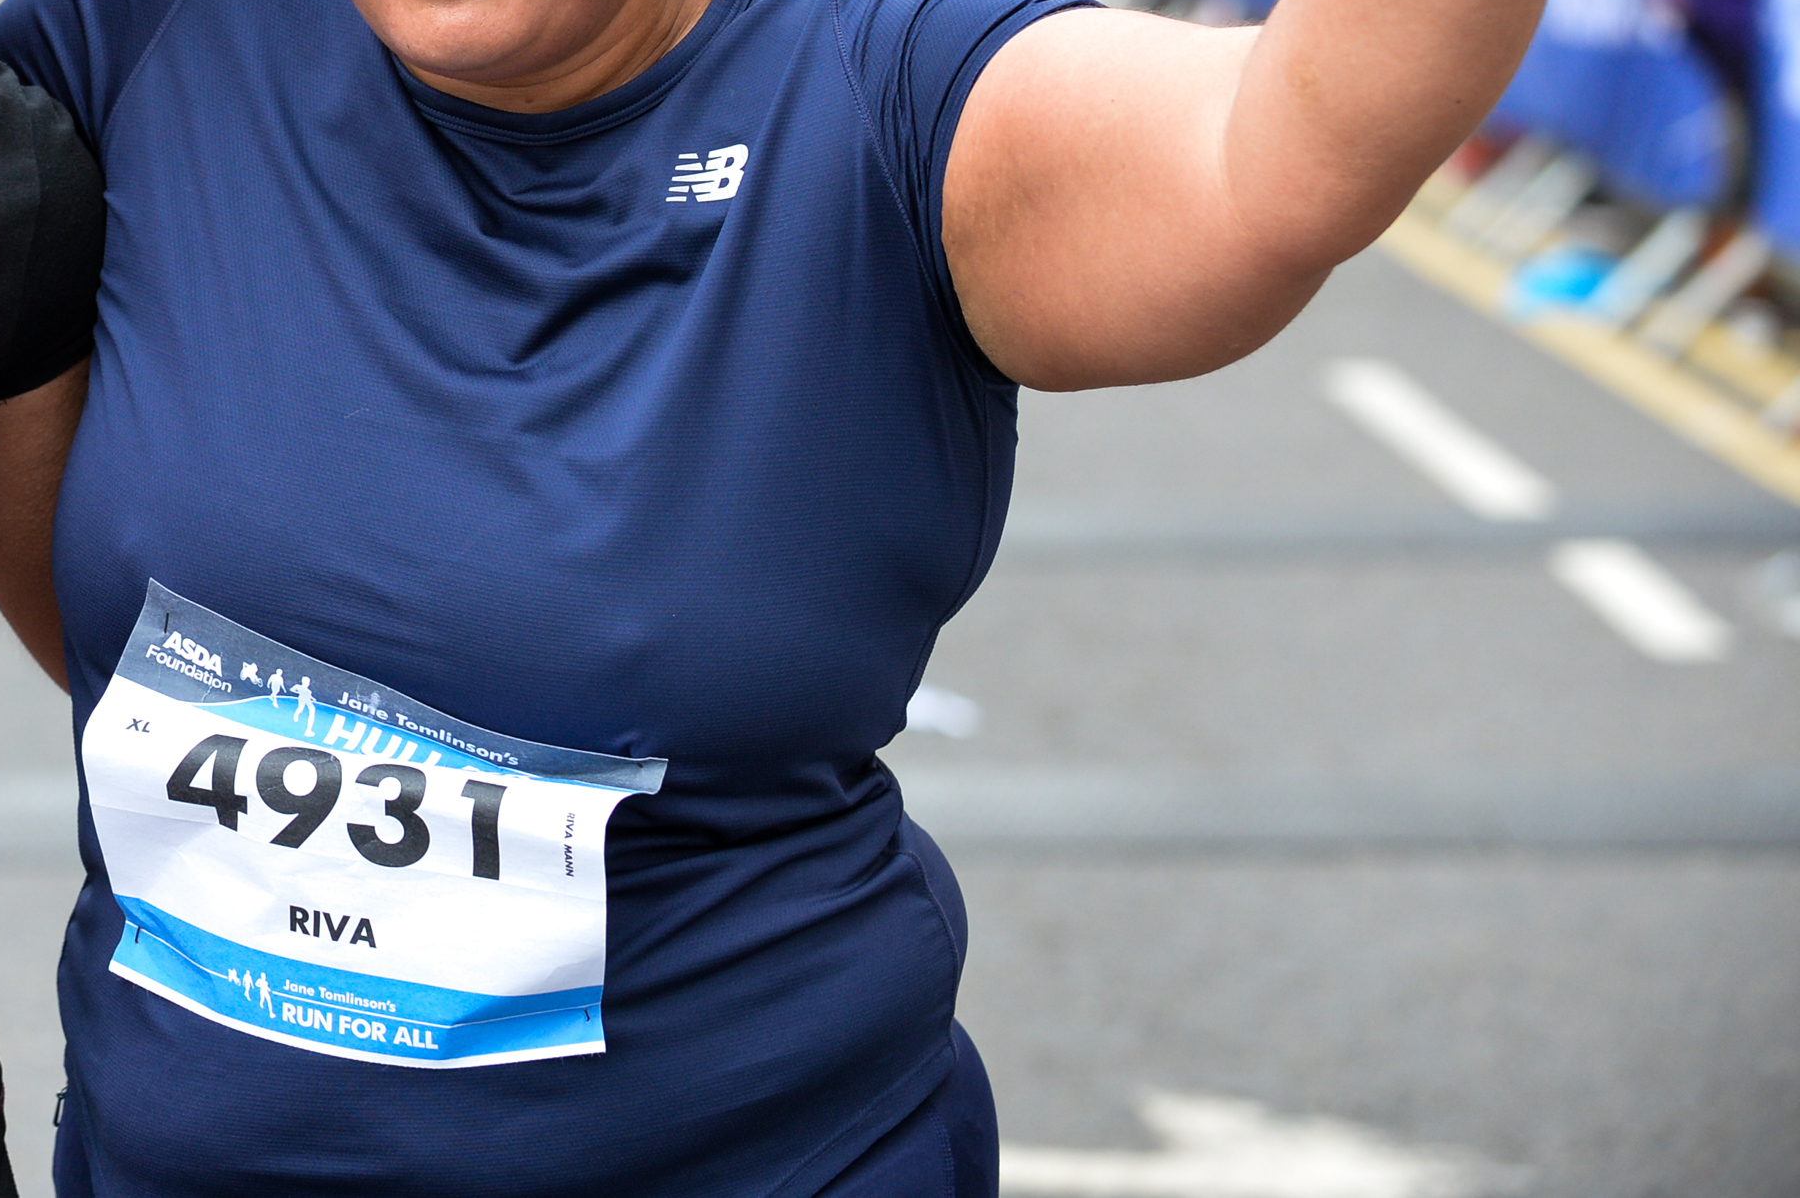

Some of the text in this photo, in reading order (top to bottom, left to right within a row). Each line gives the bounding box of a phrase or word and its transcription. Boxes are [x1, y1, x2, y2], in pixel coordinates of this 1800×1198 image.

[666, 144, 749, 202] NB
[145, 644, 232, 693] Foundation
[162, 631, 223, 677] ASDA
[126, 718, 150, 733] XL
[338, 692, 519, 766] Jane Tomlinson's
[166, 733, 508, 881] 4931
[563, 812, 576, 877] RIVA MANN
[289, 905, 377, 949] RIVA
[283, 979, 396, 1013] Jane Tomlinson's
[282, 1002, 439, 1049] RUN FOR ALL
